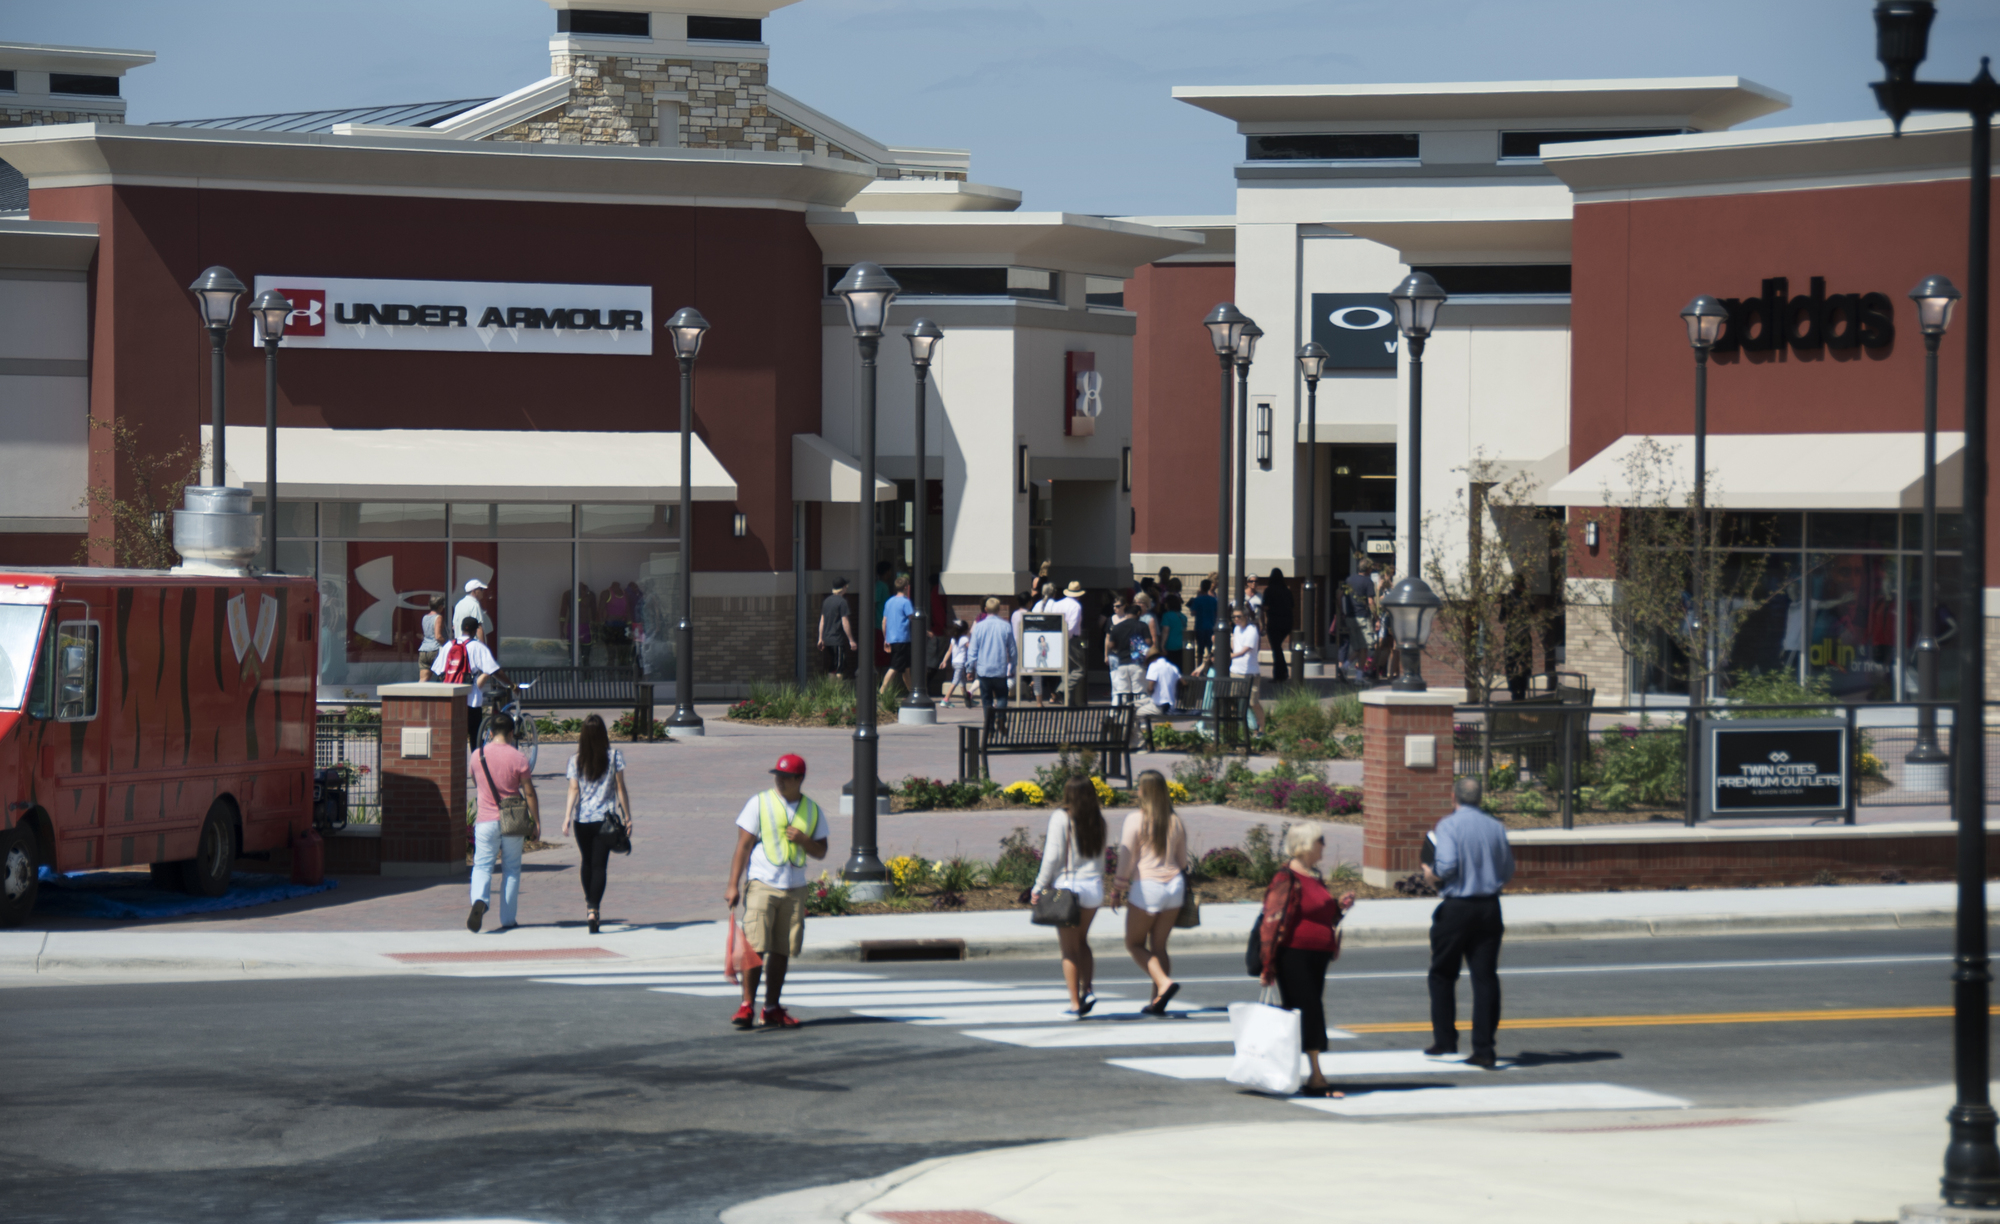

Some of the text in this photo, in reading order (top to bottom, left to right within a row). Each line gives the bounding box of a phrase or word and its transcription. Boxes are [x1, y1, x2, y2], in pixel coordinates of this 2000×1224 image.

[334, 302, 644, 331] UNDER ARMOUR
[1740, 764, 1817, 776] TWIN CITIES
[1717, 775, 1841, 788] PREMIUM OUTLETS
